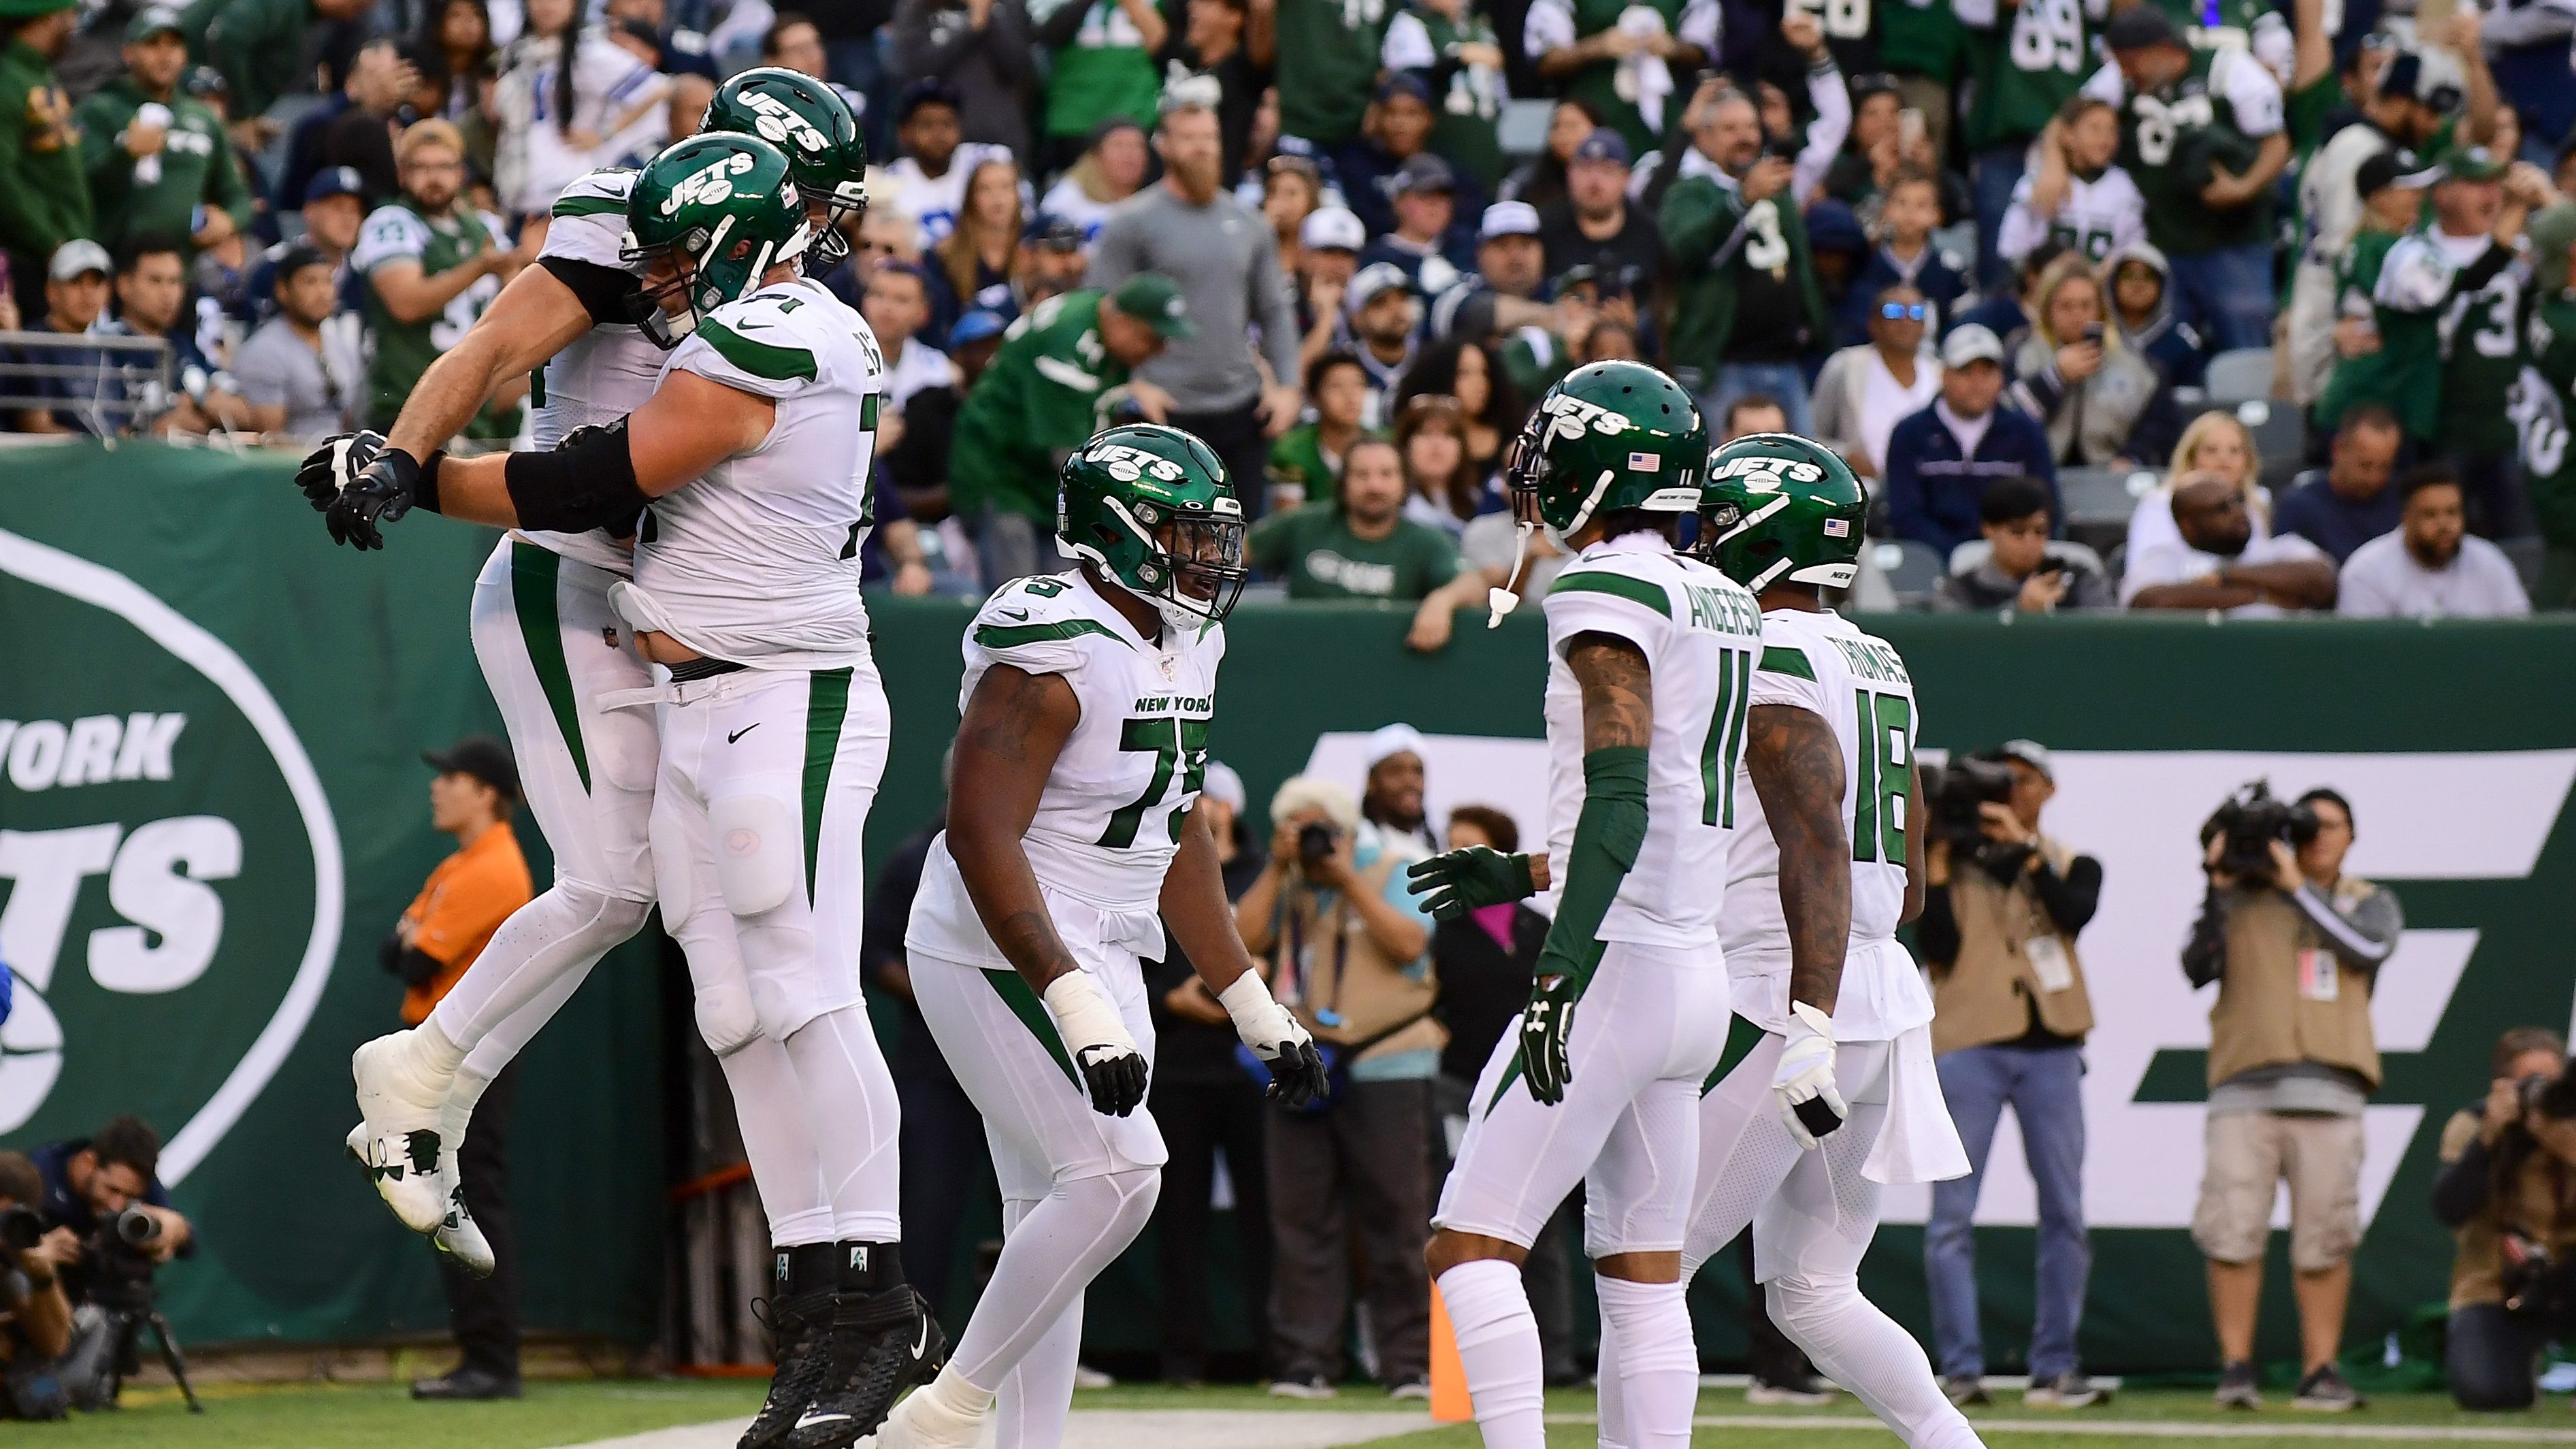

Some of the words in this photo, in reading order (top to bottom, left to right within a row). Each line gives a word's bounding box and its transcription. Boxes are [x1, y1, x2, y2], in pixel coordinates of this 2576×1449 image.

[737, 91, 830, 152] JETS
[661, 152, 754, 215] JETS
[1542, 393, 1630, 436] JETS
[1084, 444, 1184, 481] JETS
[1712, 457, 1822, 483] JETS
[1830, 571, 1852, 580] NEW
[1823, 636, 1908, 684] THOMAS
[1135, 697, 1170, 712] NEW
[1701, 648, 1750, 829] 11
[1094, 717, 1211, 849] 75
[1853, 688, 1912, 868] 18
